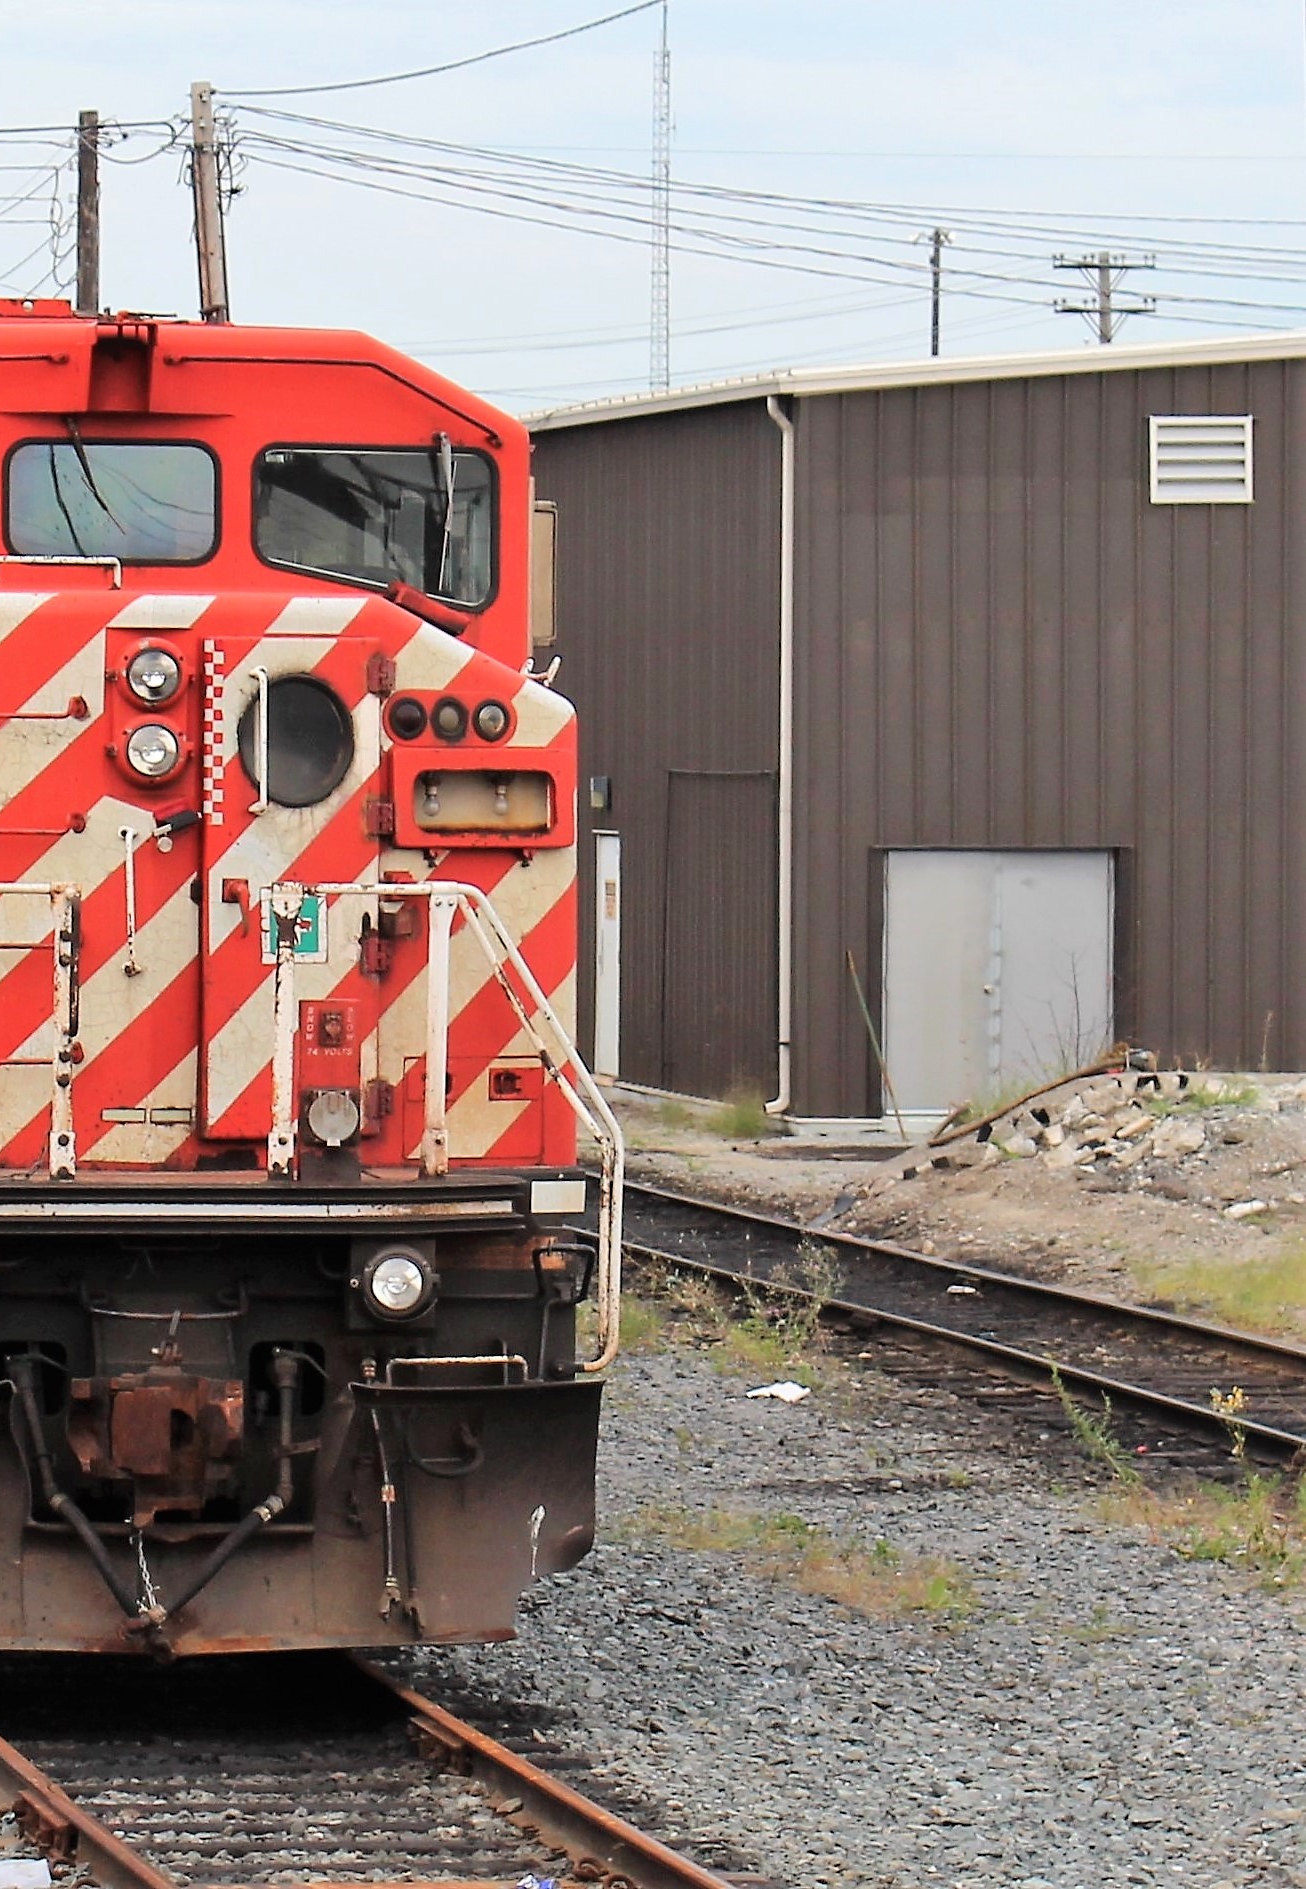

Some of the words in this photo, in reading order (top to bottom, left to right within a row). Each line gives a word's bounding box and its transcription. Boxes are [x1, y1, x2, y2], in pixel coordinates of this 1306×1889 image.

[305, 1006, 315, 1041] SNOW
[306, 1047, 319, 1056] 74
[324, 1047, 354, 1056] VOLTS
